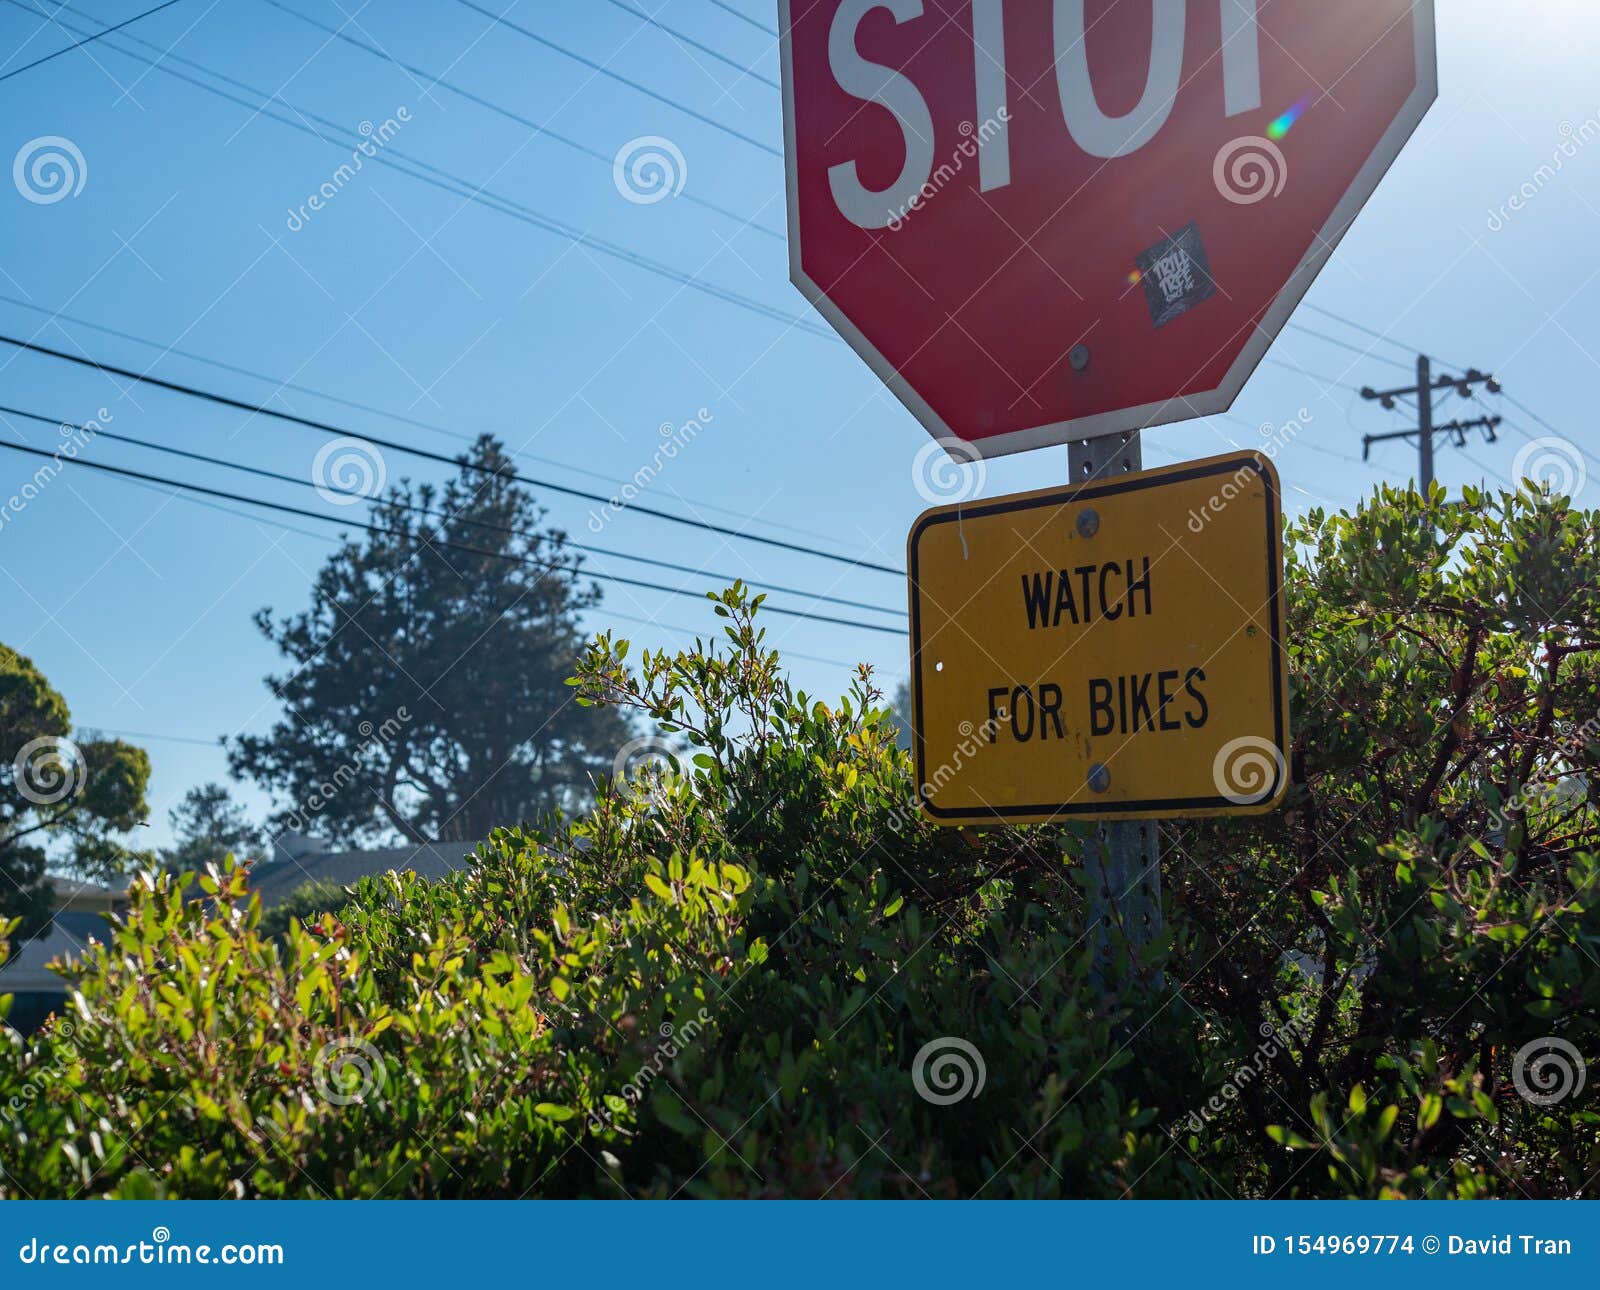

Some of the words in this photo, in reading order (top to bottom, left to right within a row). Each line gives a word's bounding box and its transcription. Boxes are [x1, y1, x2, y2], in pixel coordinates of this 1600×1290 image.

[1022, 556, 1152, 630] WATCH
[987, 683, 1066, 745] FOR
[1089, 667, 1209, 737] BIKES
